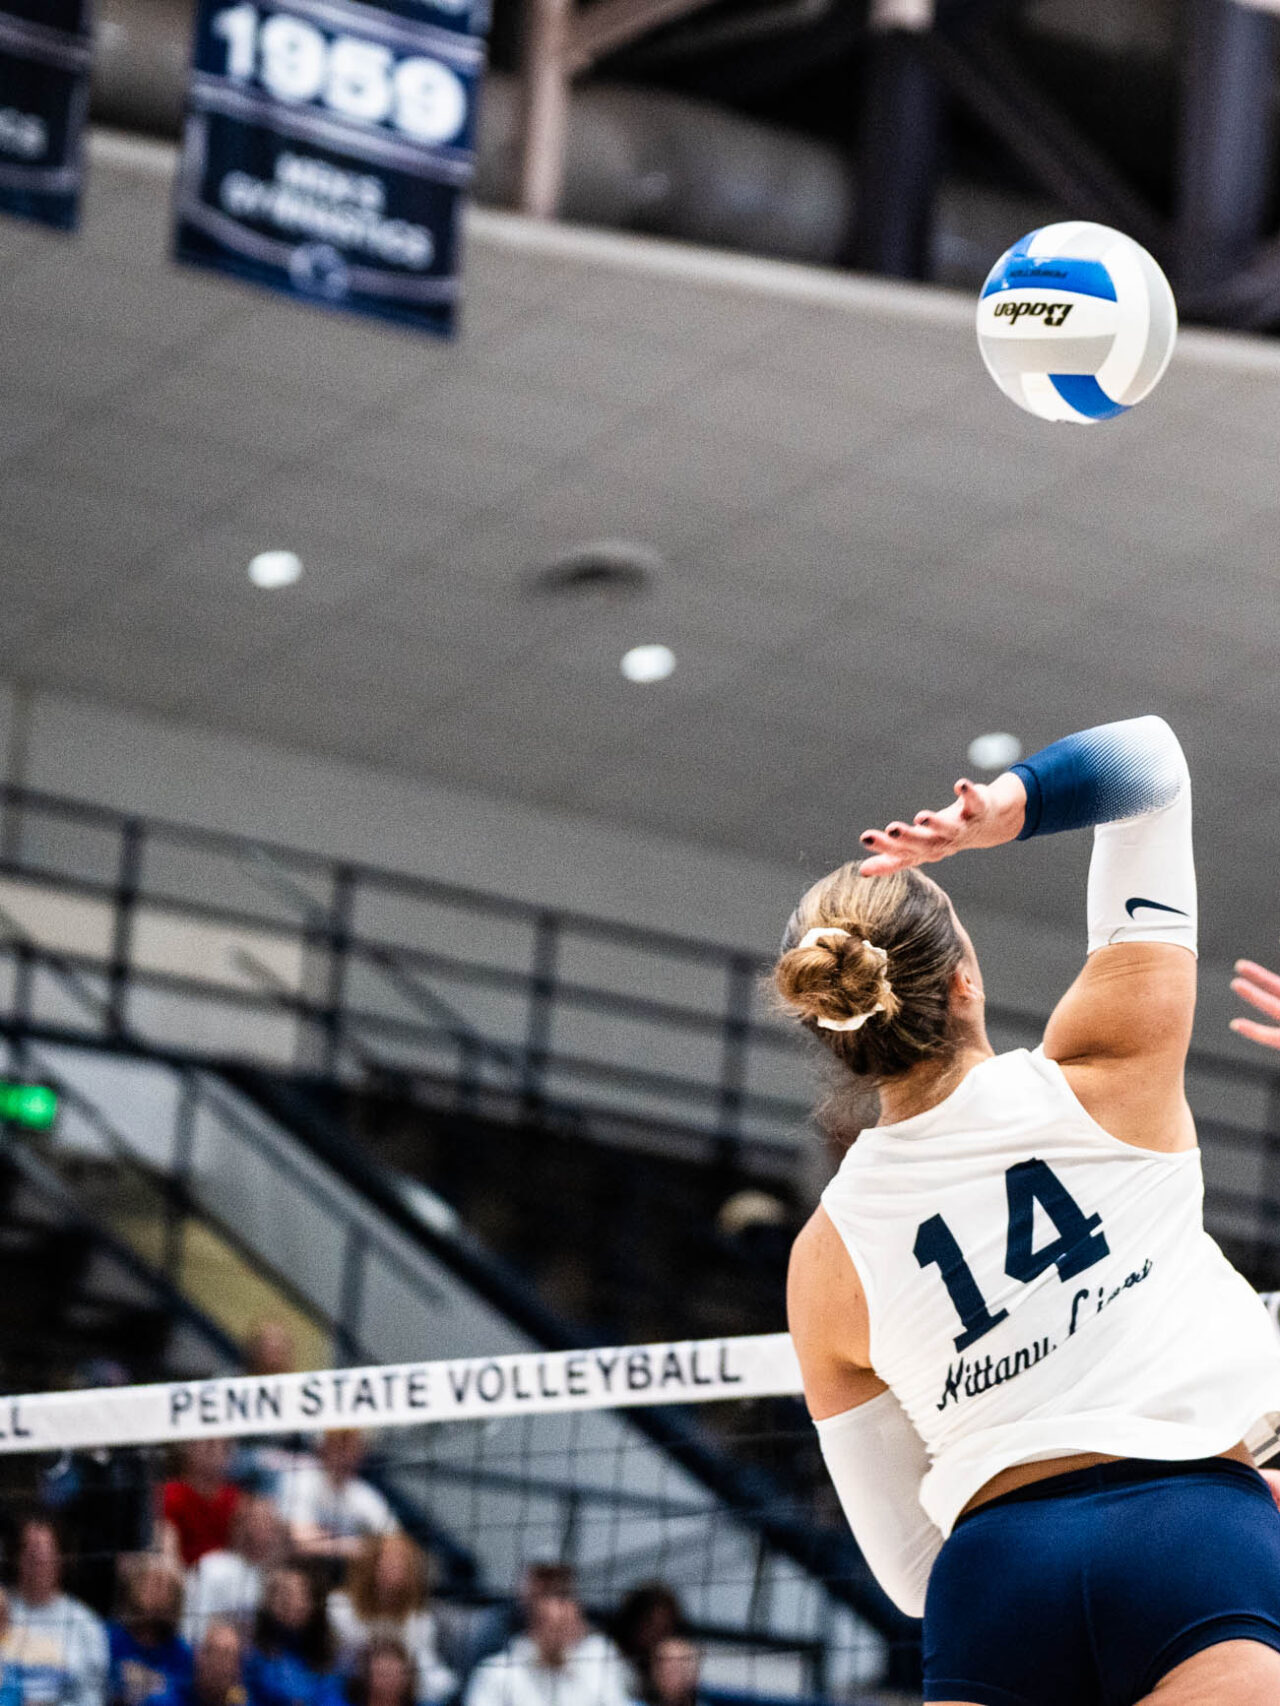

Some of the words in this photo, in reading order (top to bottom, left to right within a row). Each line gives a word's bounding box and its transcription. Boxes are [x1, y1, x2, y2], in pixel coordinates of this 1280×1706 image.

[212, 4, 466, 145] 1959
[994, 302, 1073, 326] Baden
[912, 1158, 1110, 1353] 14
[170, 1386, 282, 1426] PENN
[301, 1369, 428, 1416] STATE
[449, 1347, 742, 1403] VOLLEYBALL
